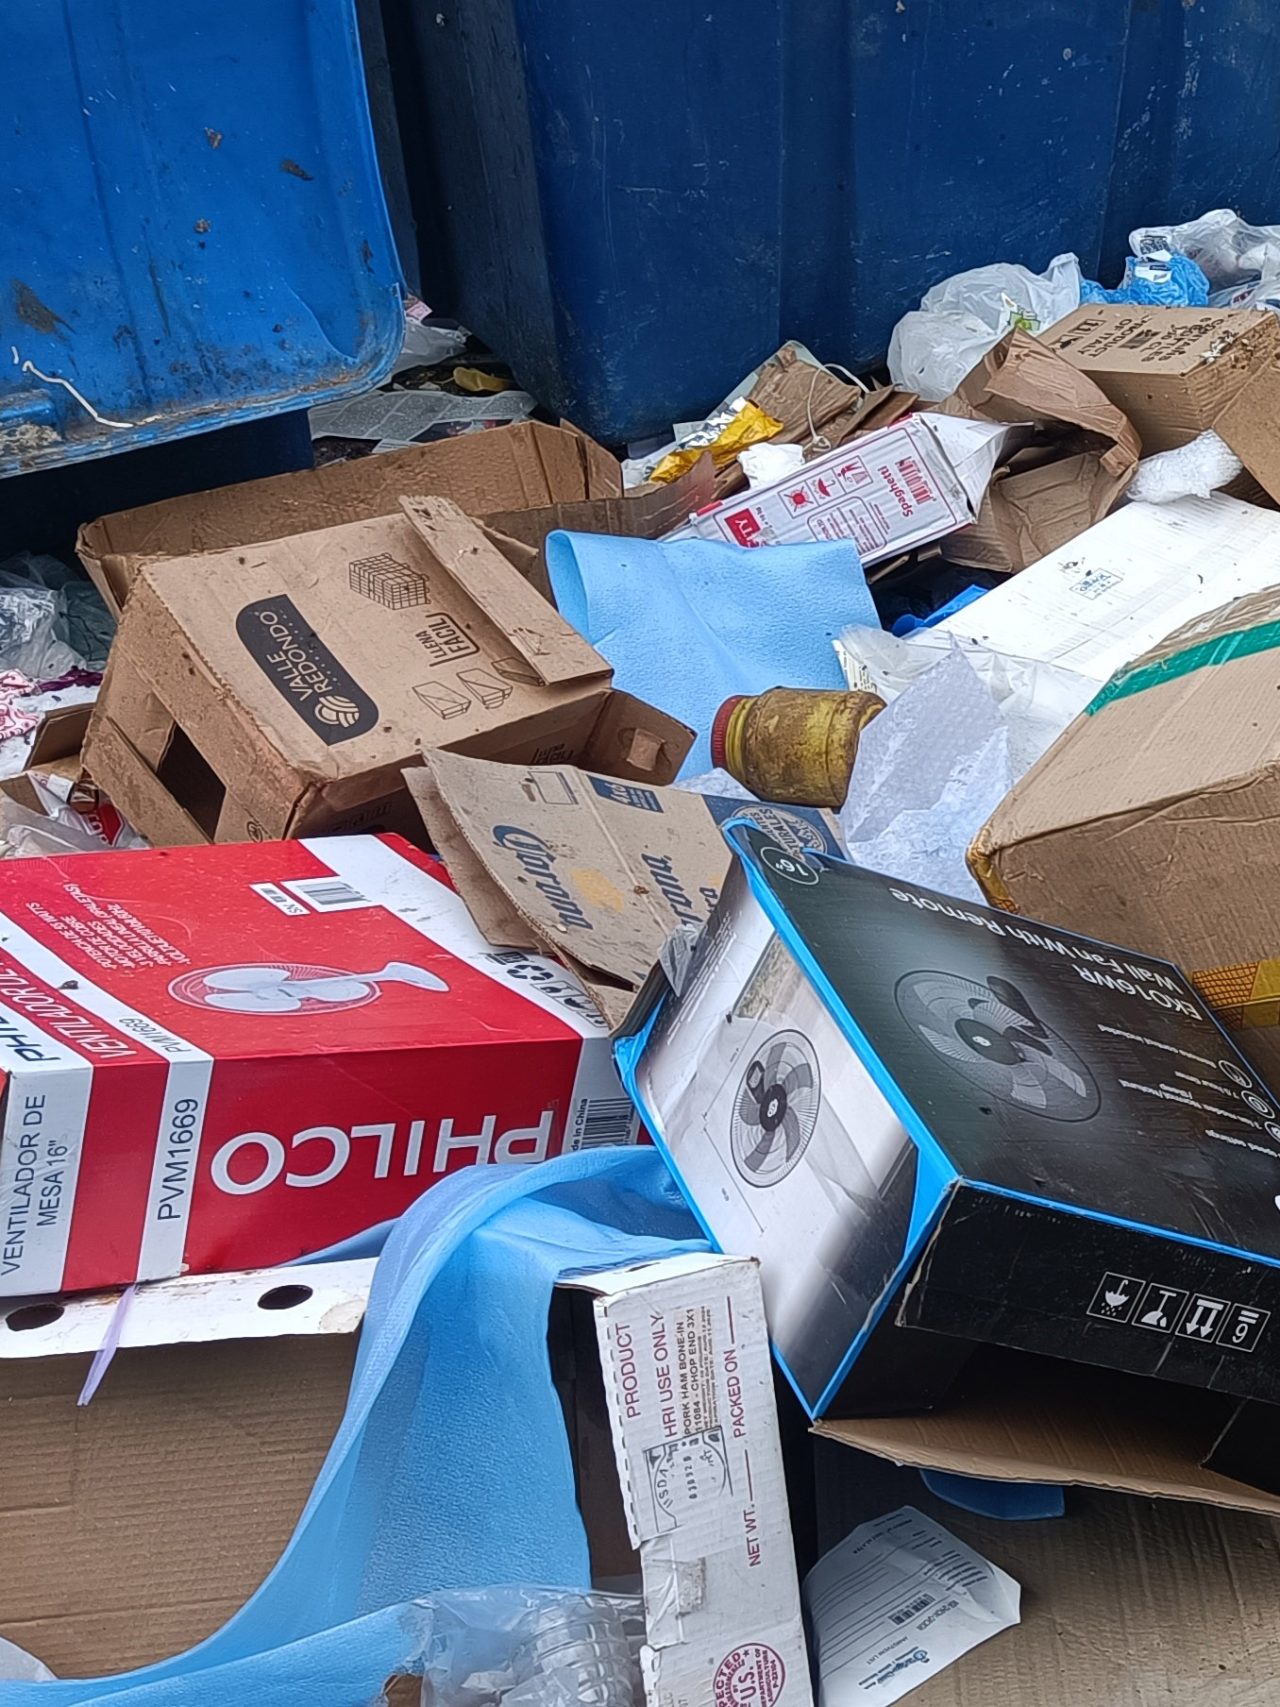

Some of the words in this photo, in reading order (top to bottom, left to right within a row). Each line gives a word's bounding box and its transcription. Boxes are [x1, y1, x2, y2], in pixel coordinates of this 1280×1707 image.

[1112, 318, 1134, 330] OF
[1078, 332, 1114, 356] ITALY
[877, 465, 913, 518] Spaghetti
[260, 611, 333, 695] REDONDO
[267, 651, 313, 701] VALLE
[493, 824, 594, 930] Corona
[889, 887, 1005, 936] Remote
[1006, 925, 1075, 958] With
[1073, 947, 1124, 974] Fan
[1124, 963, 1183, 994] Wall
[1072, 963, 1202, 1020] EKO16WR
[0, 986, 136, 1058] VENTILADOR
[119, 1017, 193, 1054] PVM1669
[575, 1098, 588, 1126] China
[157, 1099, 199, 1221] PVM1669
[210, 1110, 554, 1197] PHILCO
[1, 1132, 40, 1276] VENTILADOR
[23, 1095, 46, 1126] DE
[37, 1168, 64, 1226] MESA
[686, 1308, 695, 1328] 3X1
[650, 1314, 669, 1361] ONLY
[676, 1321, 687, 1370] BONE-IN
[687, 1331, 697, 1354] END
[615, 1323, 641, 1418] PRODUCT
[688, 1359, 700, 1391] CHOP
[723, 1349, 738, 1373] ON
[656, 1365, 673, 1402] USE
[679, 1373, 689, 1399] HAM
[661, 1406, 678, 1438] HRI
[682, 1402, 692, 1434] PORK
[727, 1376, 746, 1438] PACKED
[743, 1503, 757, 1534] WT.
[746, 1537, 761, 1567] NET
[738, 1666, 756, 1700] U.S.
